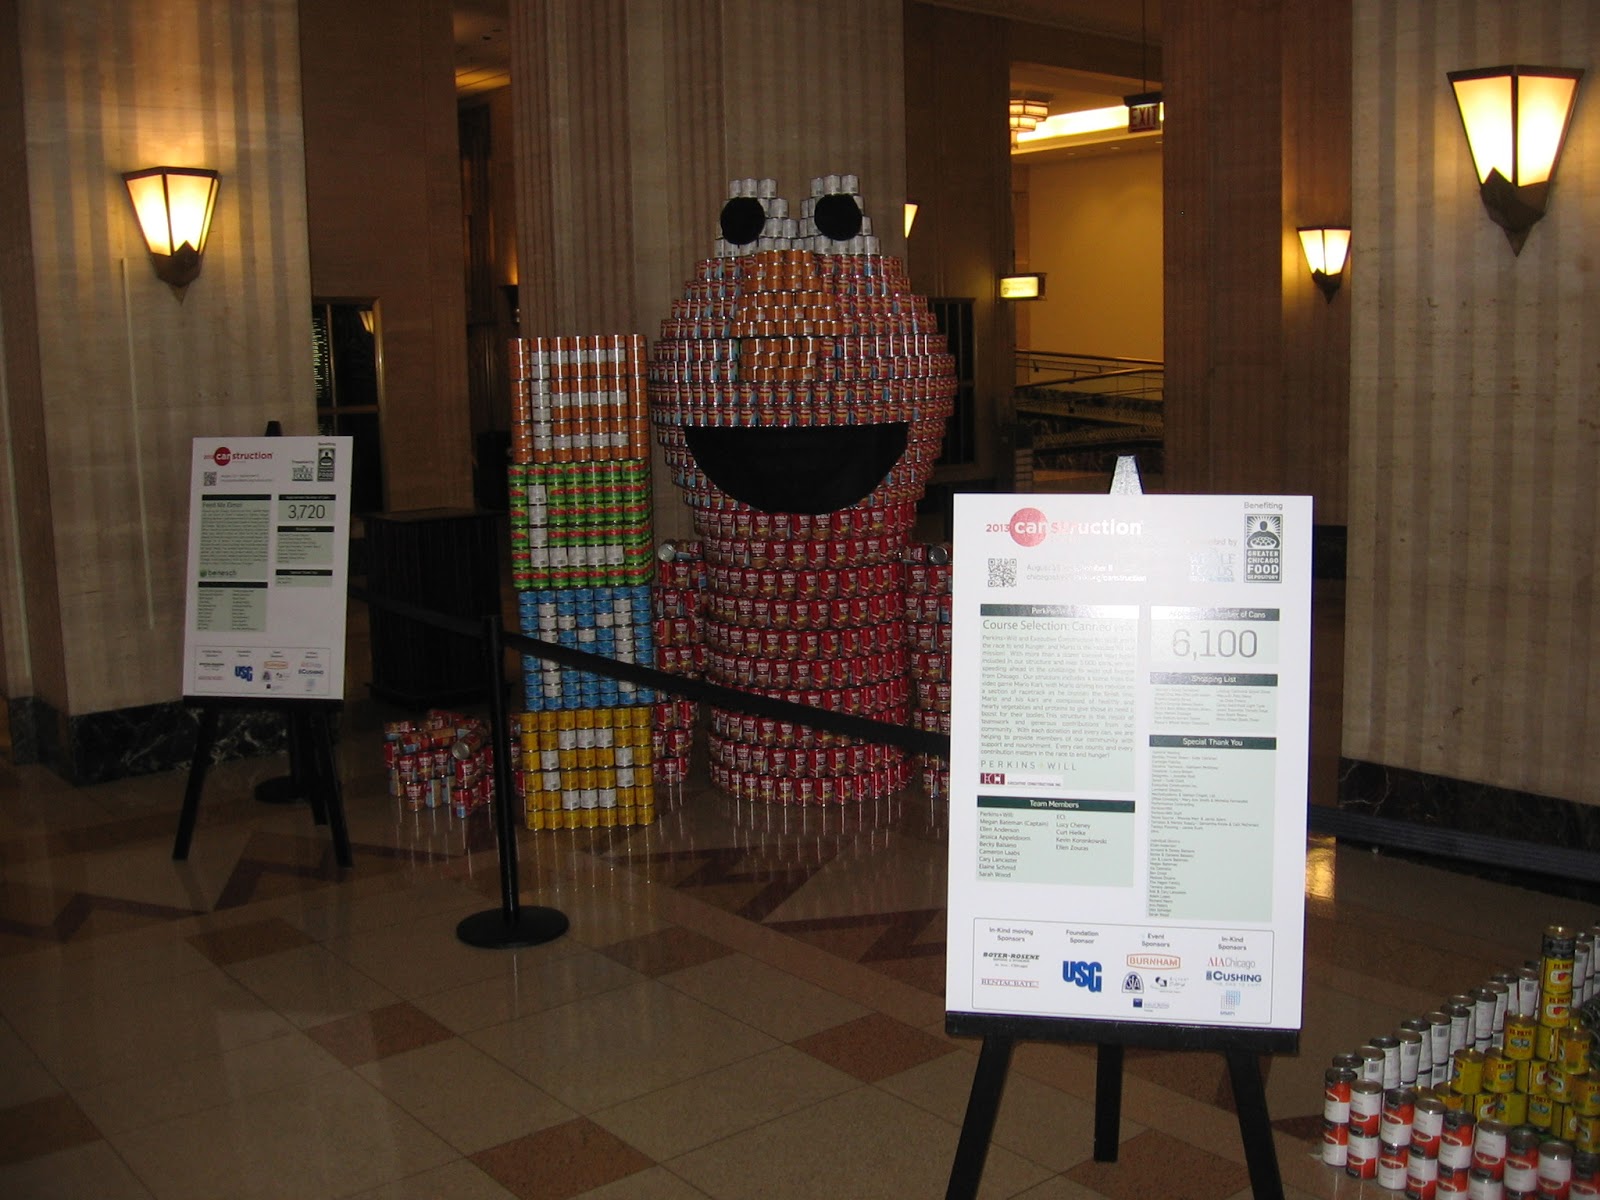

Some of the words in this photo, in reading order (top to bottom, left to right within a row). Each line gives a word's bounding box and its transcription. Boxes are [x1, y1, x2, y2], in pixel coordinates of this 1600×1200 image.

[1130, 106, 1158, 128] EXIT
[216, 452, 272, 460] canstruction
[288, 504, 326, 520] 3,720
[1244, 502, 1283, 510] Benefiting
[986, 524, 1010, 533] 2013
[1247, 564, 1279, 574] FOOD
[983, 620, 1018, 630] Course
[1172, 629, 1257, 661] 6,100
[234, 666, 253, 682] USG
[980, 760, 1036, 769] PERKINS
[1048, 762, 1077, 770] WILL
[1130, 954, 1178, 966] BURNHAM
[1063, 960, 1102, 992] USG
[1213, 971, 1262, 983] CUSHING
